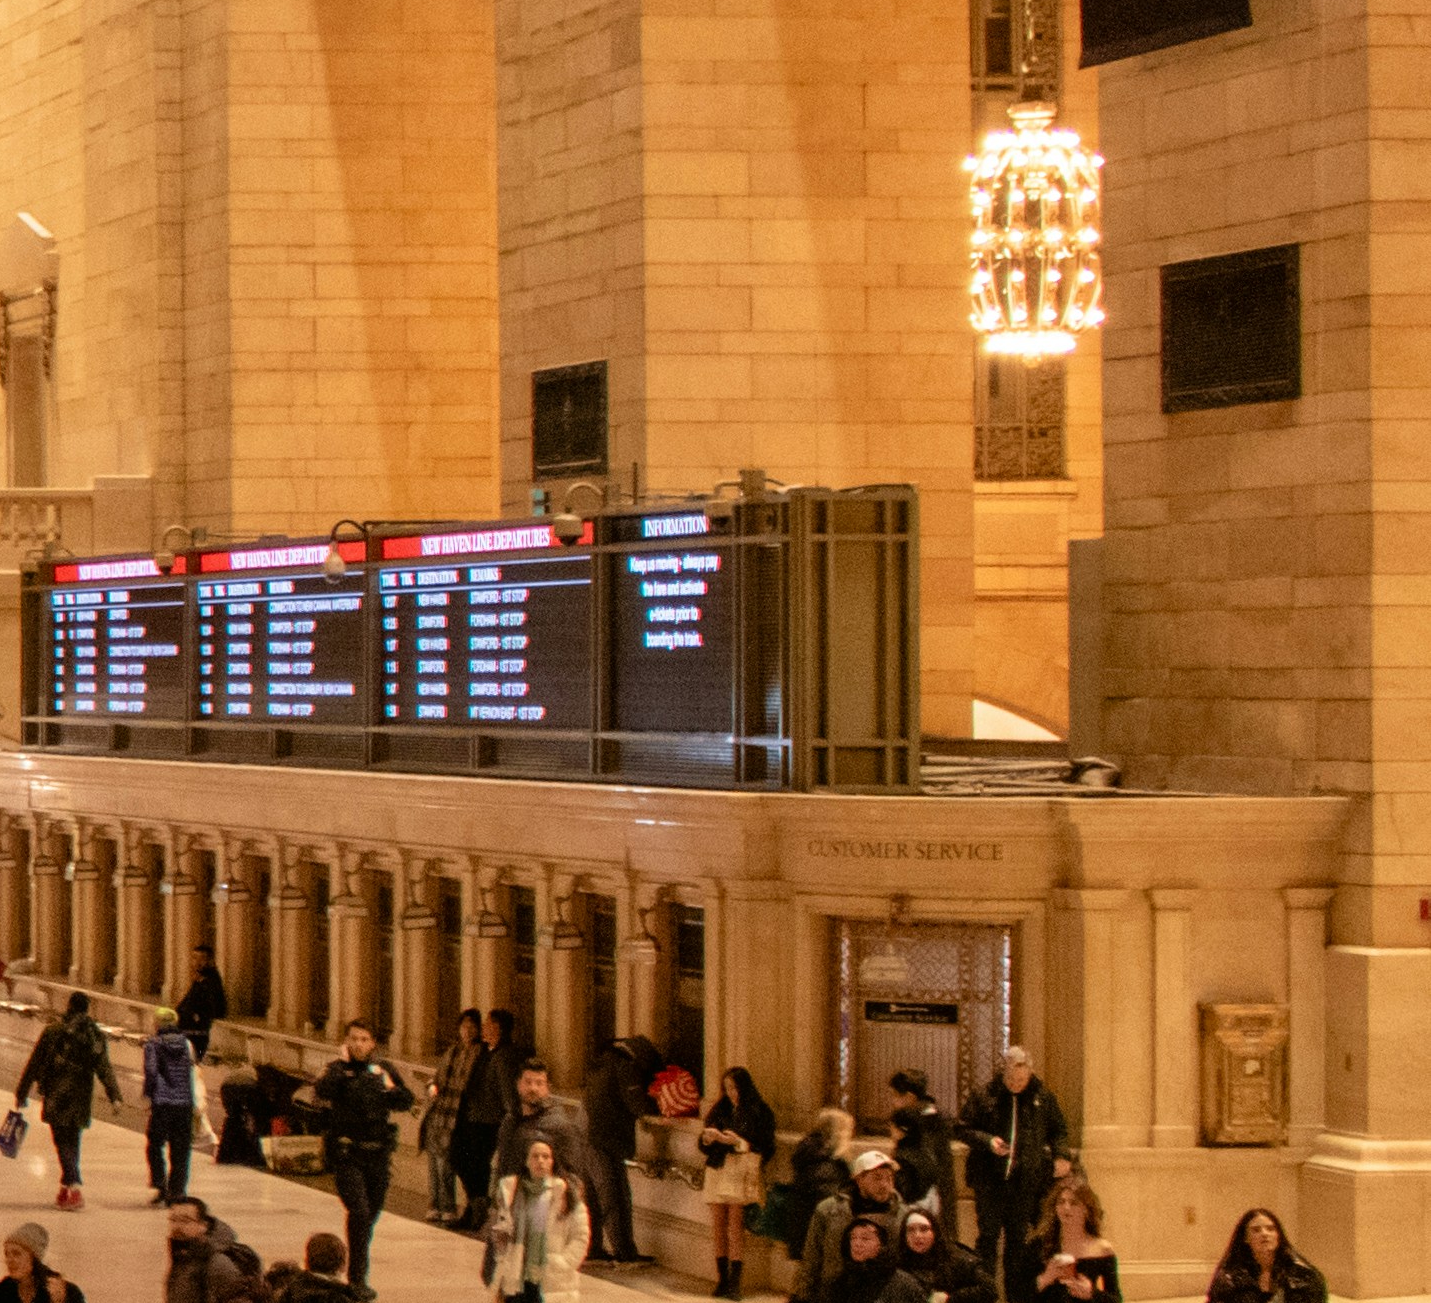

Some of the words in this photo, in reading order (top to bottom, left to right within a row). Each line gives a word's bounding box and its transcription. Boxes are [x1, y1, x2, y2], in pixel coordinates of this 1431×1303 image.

[643, 515, 709, 537] INFORMATION
[421, 535, 441, 555] NEW
[442, 532, 471, 554] HAVEN
[473, 530, 493, 552] LINE
[494, 527, 550, 550] DEPARTURES
[231, 551, 246, 570] NEW
[247, 549, 270, 569] HAVEN
[271, 548, 288, 567] LINE
[808, 840, 909, 860] CUSTOMER
[915, 842, 1004, 861] SERVICE
